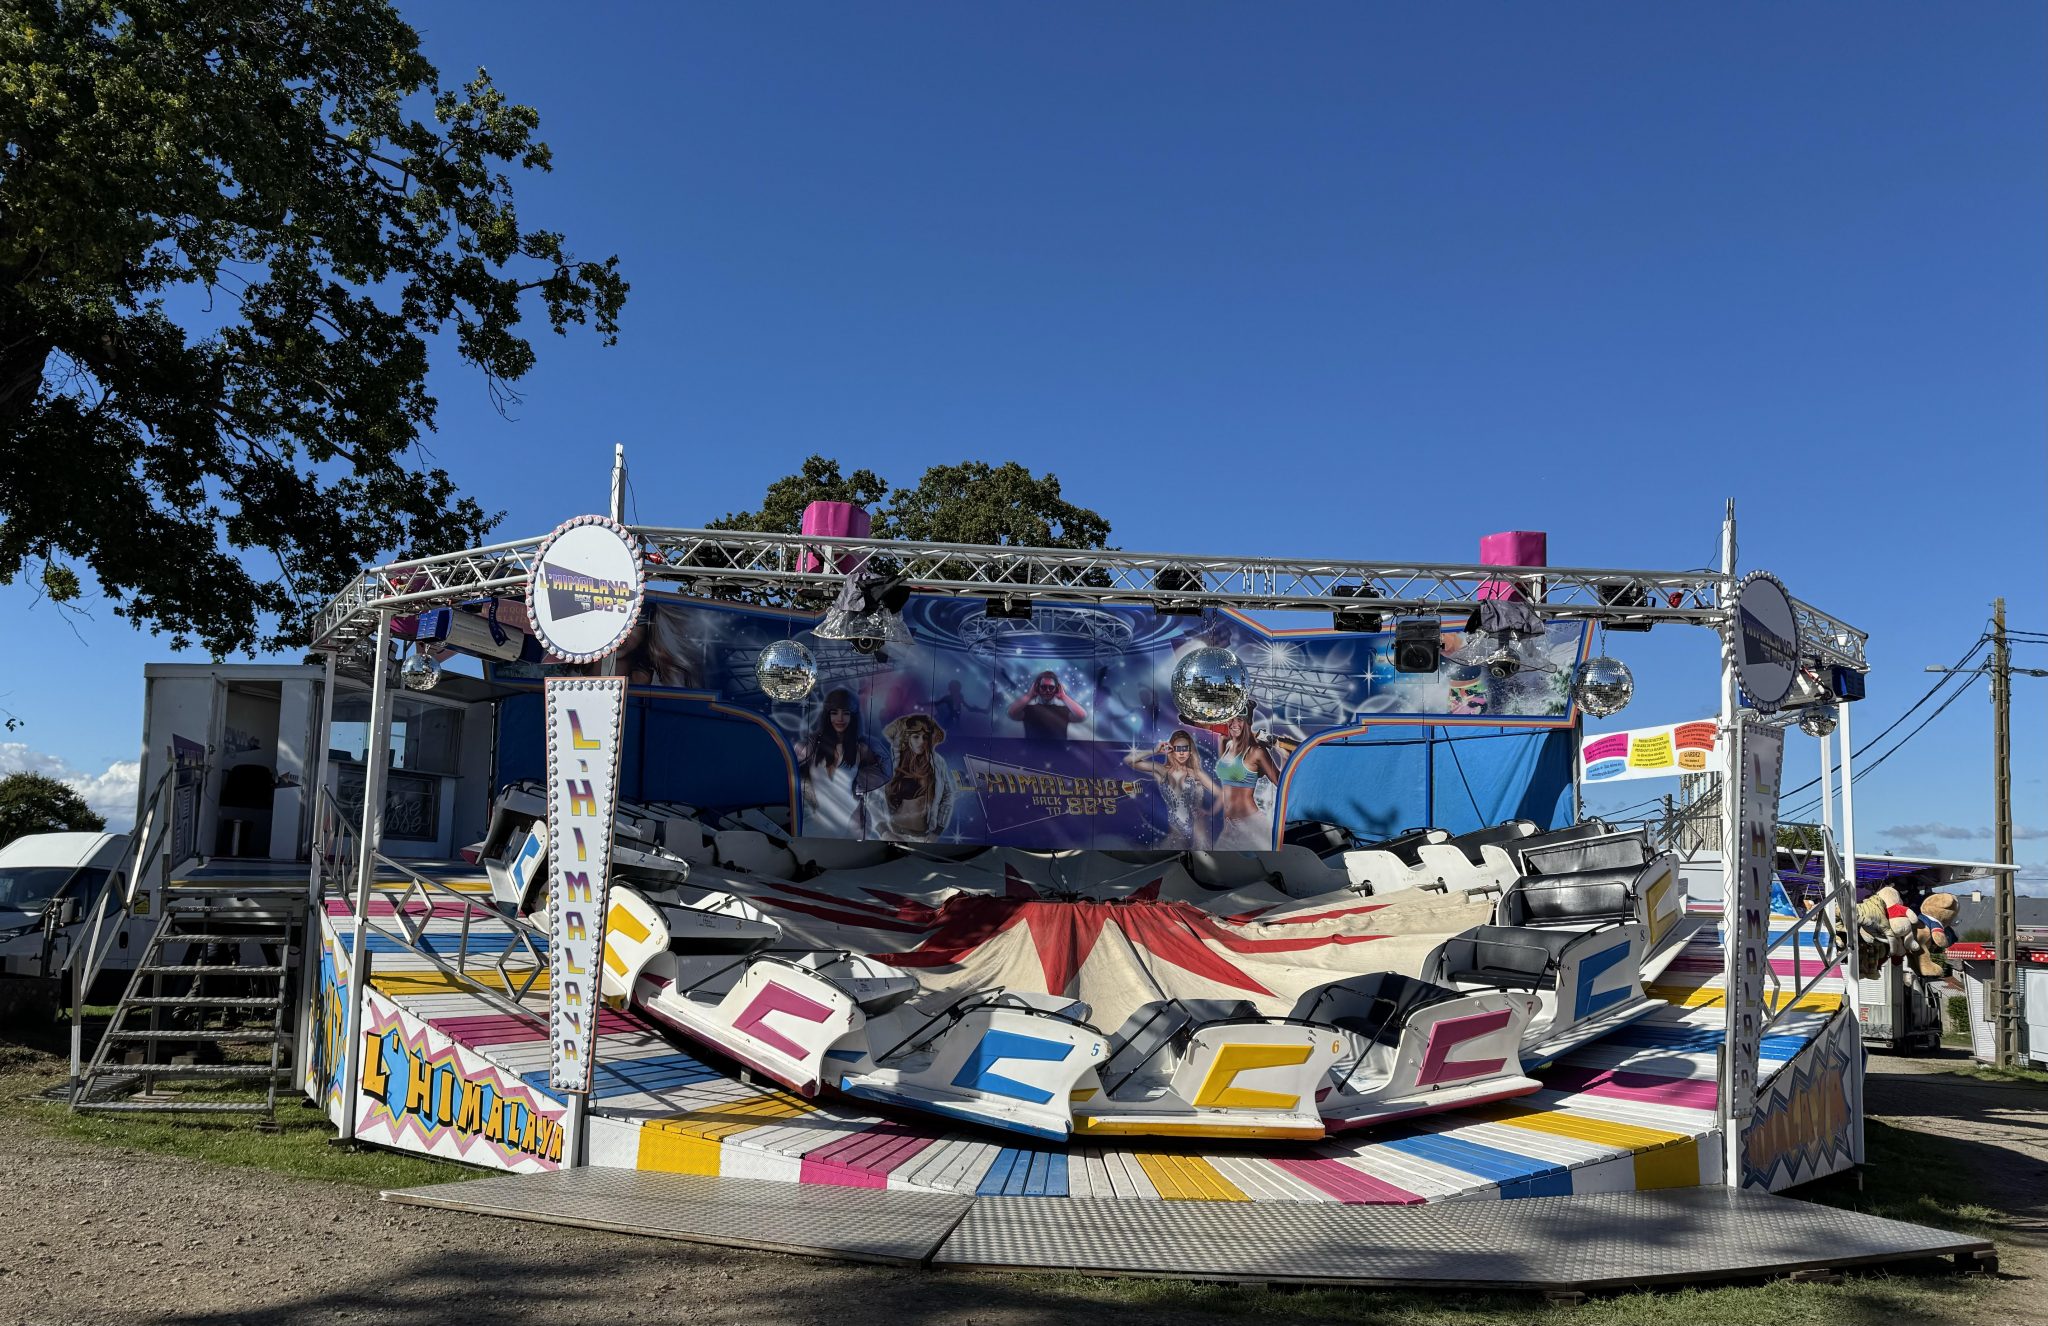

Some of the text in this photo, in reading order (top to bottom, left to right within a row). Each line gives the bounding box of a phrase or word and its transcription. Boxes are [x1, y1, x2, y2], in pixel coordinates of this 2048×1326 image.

[539, 573, 630, 597] L'HIMALAYA
[1032, 796, 1061, 806] BACK
[1045, 806, 1061, 817] TO
[562, 708, 602, 1062] L'HIMALAYA
[1741, 752, 1771, 1089] L'HIMALAYA
[1526, 1001, 1534, 1016] 7
[1090, 1042, 1101, 1057] 5
[1331, 1039, 1340, 1054] 6
[361, 1030, 564, 1165] L'HIMALAYA
